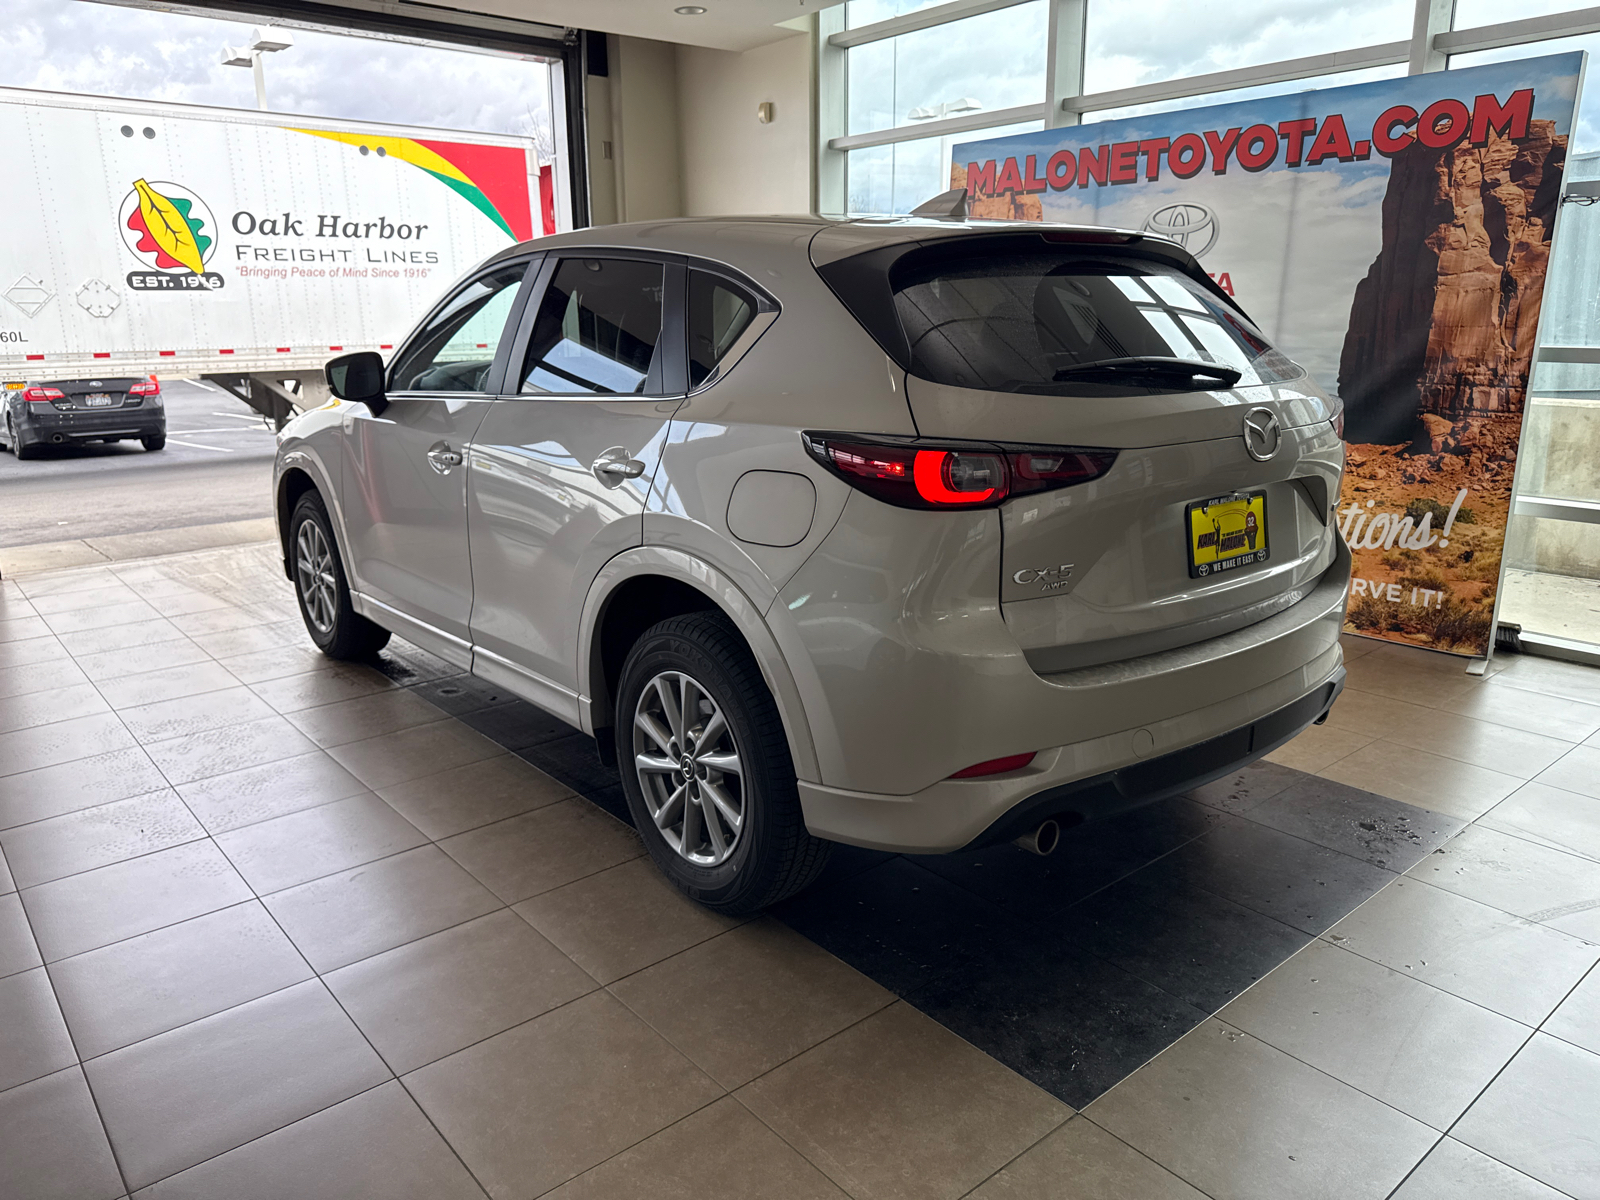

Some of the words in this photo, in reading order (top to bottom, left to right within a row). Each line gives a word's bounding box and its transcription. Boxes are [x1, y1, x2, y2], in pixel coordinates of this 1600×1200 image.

[967, 88, 1535, 198] MALONETOYOTA.COM
[231, 211, 304, 237] Oak
[315, 214, 429, 240] Harbor
[236, 245, 352, 262] FREIGHT
[366, 248, 439, 263] LINES
[236, 265, 287, 280] "Bringing
[291, 266, 326, 277] Peace
[328, 267, 341, 278] of
[342, 267, 368, 278] Mind
[371, 267, 400, 278] Since
[403, 268, 432, 278] 1916"
[131, 276, 175, 288] EST.
[0, 331, 28, 342] 60L
[1247, 516, 1255, 527] 32
[1337, 488, 1468, 550] tions!
[1197, 531, 1217, 549] KARL
[1220, 533, 1246, 553] MALONE
[1213, 563, 1222, 572] WE
[1222, 559, 1236, 570] MAKE
[1237, 557, 1242, 566] IT
[1242, 554, 1254, 564] EASY
[1013, 563, 1075, 585] CX-5
[1041, 581, 1069, 591] AWD
[1351, 578, 1402, 603] RVE
[1411, 587, 1443, 609] IT!
